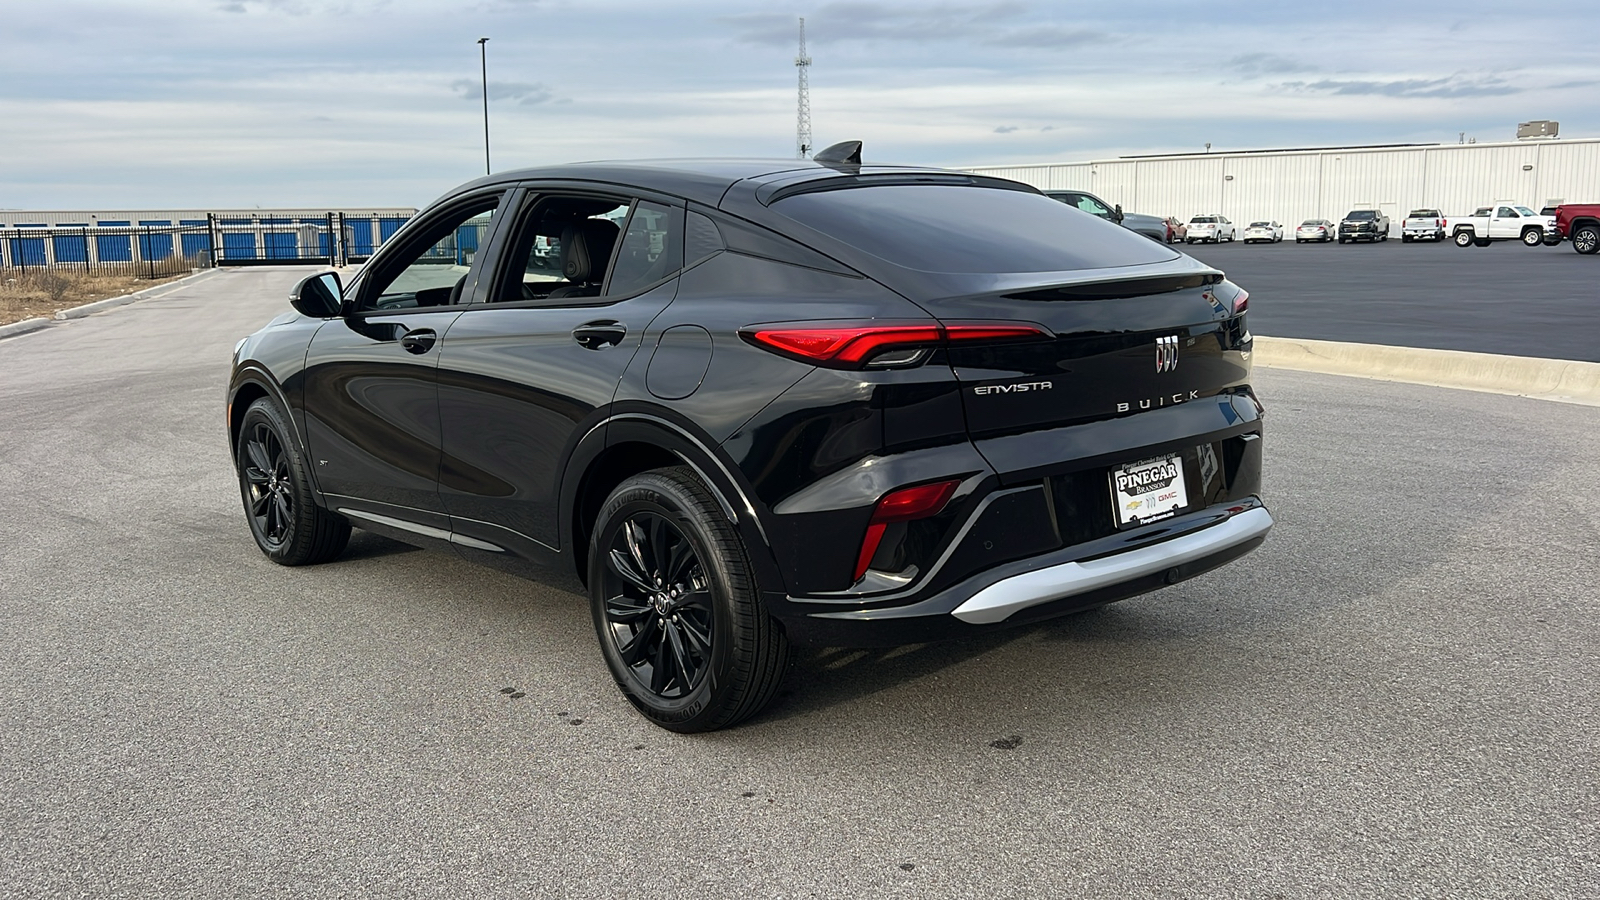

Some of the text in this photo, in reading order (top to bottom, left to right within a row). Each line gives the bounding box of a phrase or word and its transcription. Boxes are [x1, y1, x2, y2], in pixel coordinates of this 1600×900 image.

[974, 381, 1053, 395] ENVISTA
[1116, 389, 1199, 413] BUICK
[1118, 464, 1177, 490] PINEGAR
[1136, 481, 1165, 494] BRANSON
[1158, 491, 1177, 501] GMC
